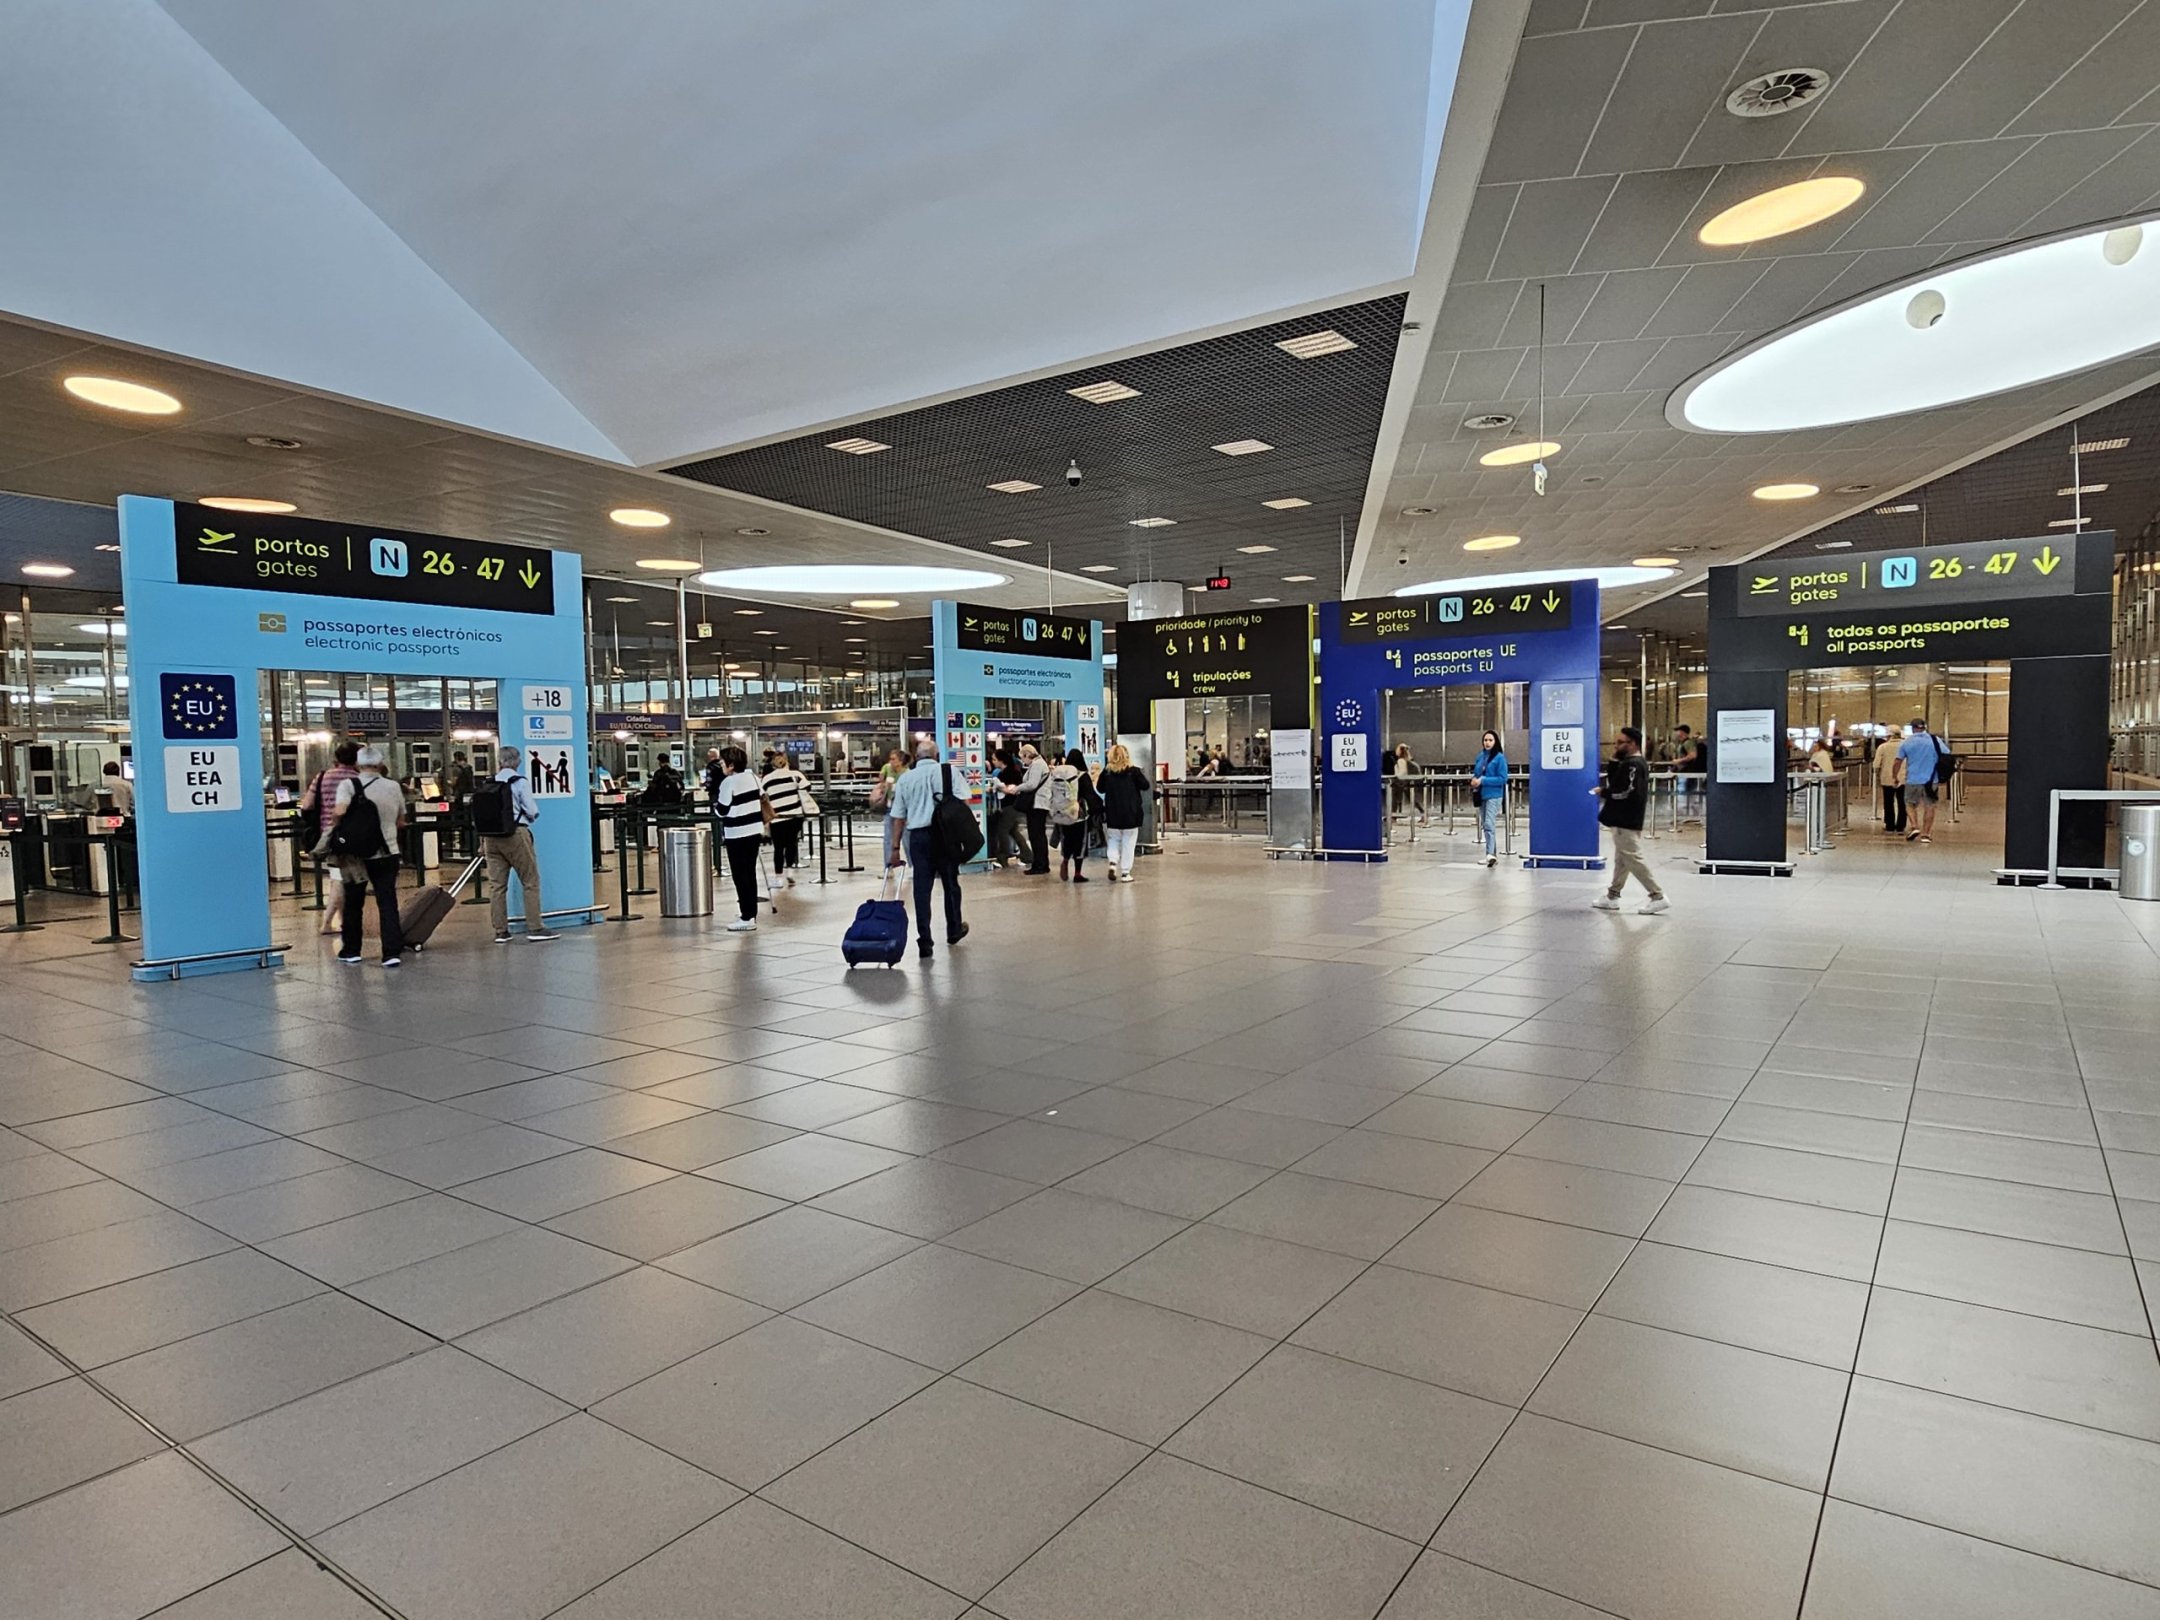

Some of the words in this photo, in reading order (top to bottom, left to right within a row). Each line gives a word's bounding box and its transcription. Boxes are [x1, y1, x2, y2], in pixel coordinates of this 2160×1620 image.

[255, 537, 330, 558] portas
[256, 559, 318, 578] gates
[380, 545, 400, 570] N
[422, 550, 455, 576] 26
[476, 556, 505, 581] 47
[1890, 563, 1908, 582] N
[1929, 557, 1962, 579] 26
[1984, 552, 2018, 575] 47
[1789, 571, 1848, 590] portas
[1790, 588, 1838, 605] gates
[1445, 602, 1457, 618] N
[1472, 598, 1495, 615] 26
[1509, 594, 1532, 612] 47
[1376, 608, 1417, 623] portas
[304, 619, 408, 637] passaportes
[412, 626, 502, 643] electrónicos
[983, 620, 1010, 632] portas
[1026, 622, 1034, 637] N
[1041, 624, 1054, 639] 26
[1061, 627, 1073, 640] 47
[1155, 619, 1206, 634] prioridade
[1214, 616, 1249, 629] priority
[1251, 615, 1262, 623] to
[1376, 622, 1410, 636] gates
[1827, 625, 1874, 639] todos
[1877, 624, 1897, 636] os
[1900, 616, 2010, 636] passaportes
[305, 635, 384, 652] electronic
[388, 640, 460, 656] passports
[983, 633, 1006, 644] gates
[1826, 640, 1844, 653] all
[1848, 636, 1925, 654] passports
[1414, 648, 1493, 665] passaportes
[1500, 644, 1517, 657] UE
[998, 667, 1036, 677] passaportes
[1193, 670, 1251, 684] tripulações
[1414, 662, 1473, 678] passports
[1479, 661, 1494, 672] EU
[999, 677, 1027, 686] electronic
[1028, 679, 1055, 688] passports
[1193, 685, 1216, 694] crew
[531, 690, 561, 707] +18
[186, 700, 213, 716] EU
[1082, 707, 1095, 718] +18
[1342, 708, 1355, 718] EU
[1343, 737, 1355, 746] EU
[1555, 731, 1569, 741] EU
[1341, 748, 1357, 756] EEA
[1552, 744, 1572, 753] EEA
[190, 751, 215, 766] EU
[1342, 759, 1355, 767] CH
[1554, 756, 1570, 765] CH
[186, 771, 222, 786] EEA
[191, 791, 218, 806] CH
